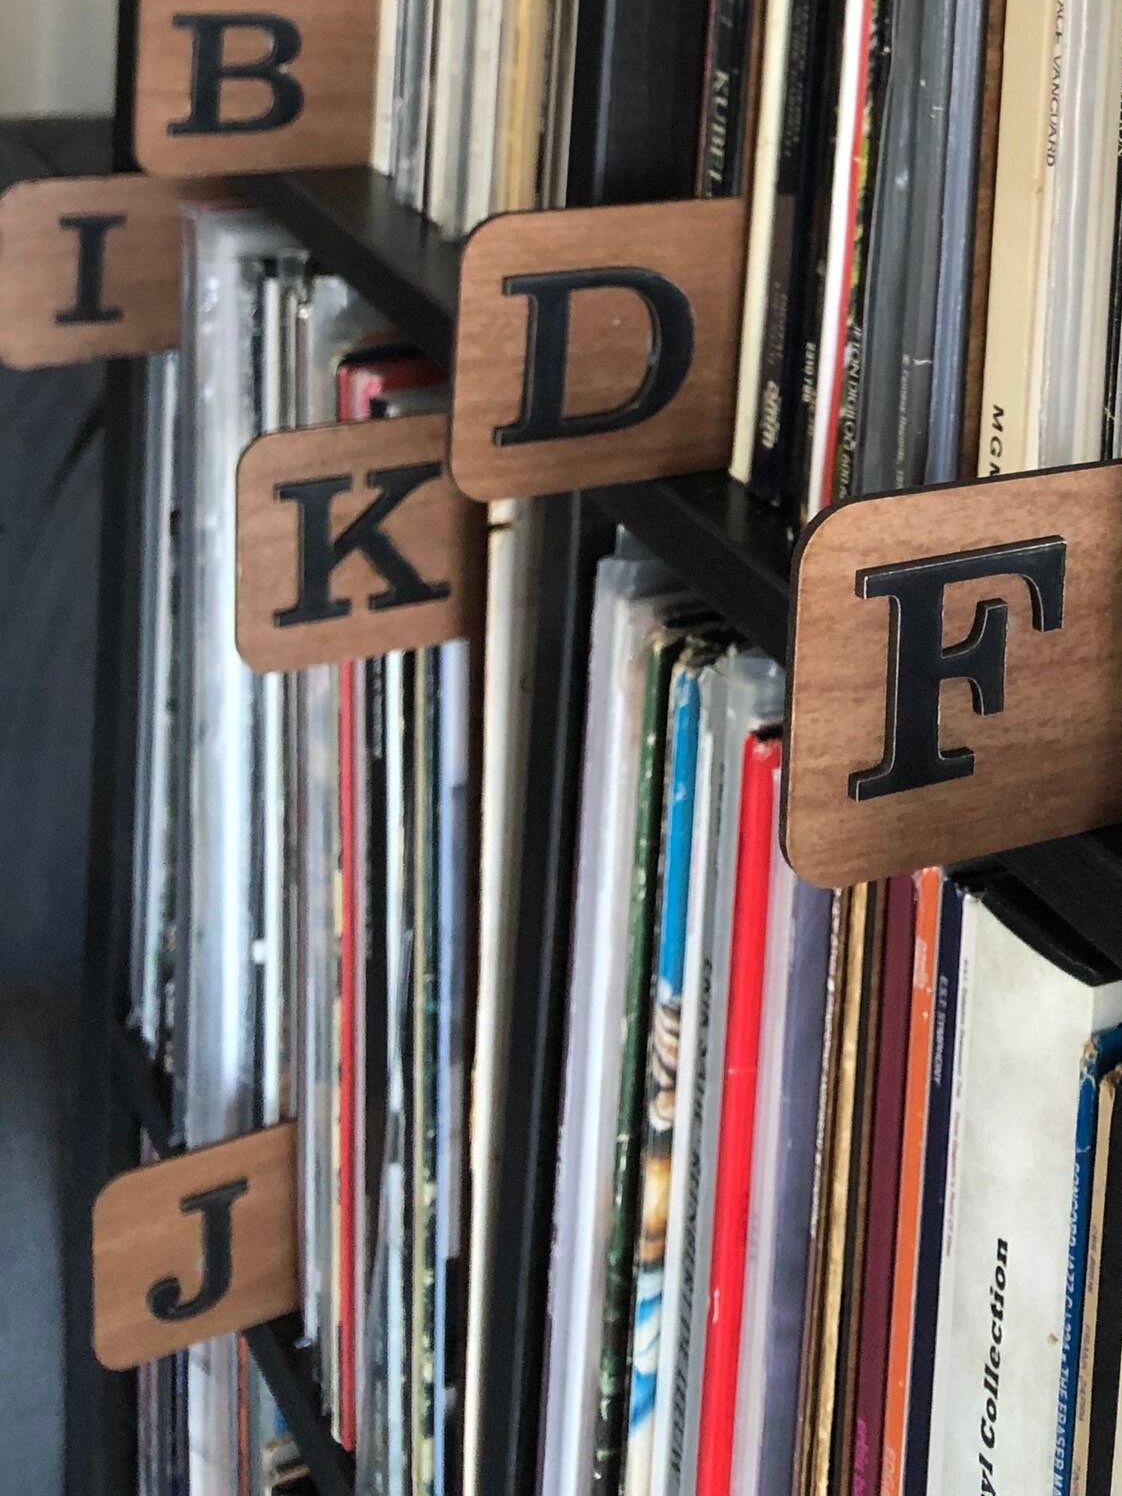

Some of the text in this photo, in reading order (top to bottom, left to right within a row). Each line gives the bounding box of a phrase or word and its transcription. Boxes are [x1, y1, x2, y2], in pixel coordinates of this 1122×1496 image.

[167, 12, 302, 136] B
[56, 215, 127, 323] I
[492, 265, 695, 446] D
[273, 461, 450, 627] K
[848, 535, 1067, 802] F
[146, 1176, 249, 1321] J
[977, 1238, 1010, 1450] Collection
